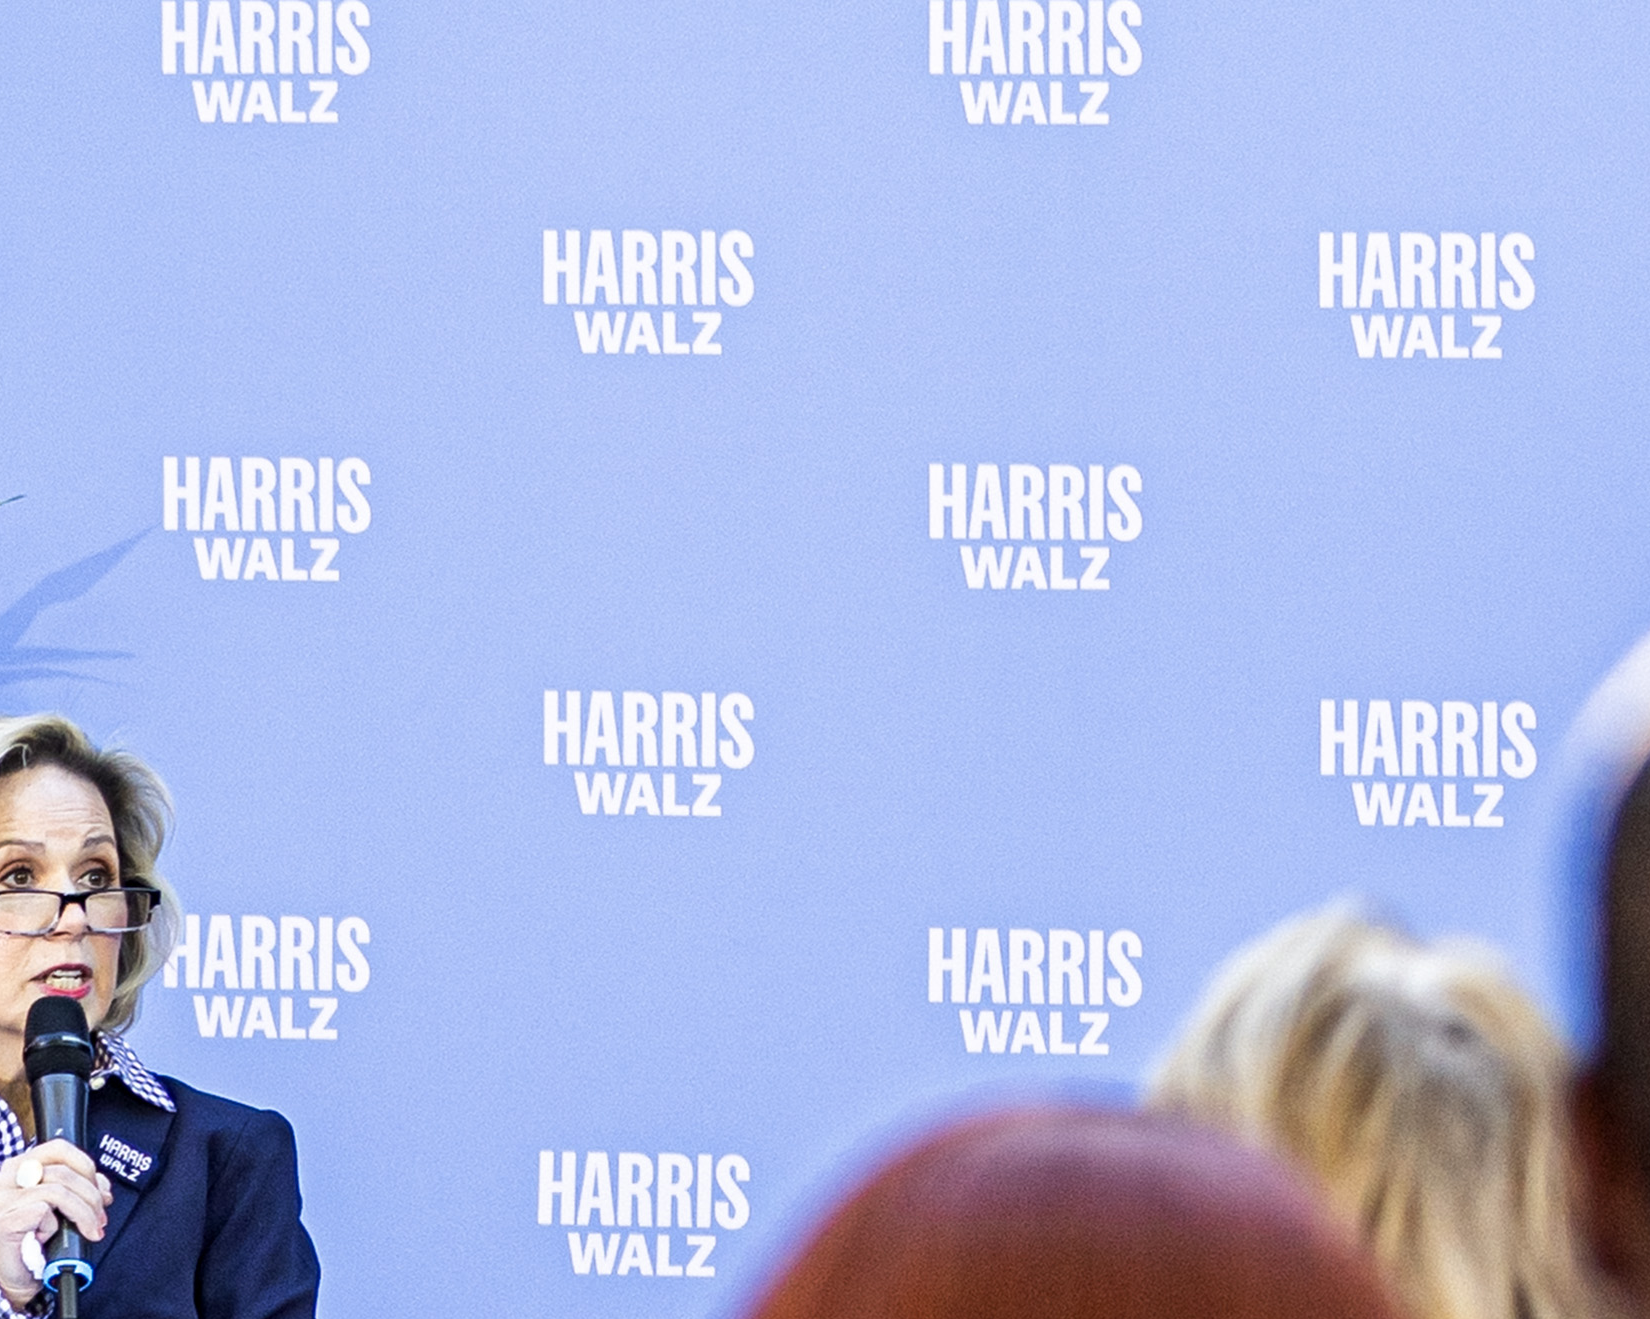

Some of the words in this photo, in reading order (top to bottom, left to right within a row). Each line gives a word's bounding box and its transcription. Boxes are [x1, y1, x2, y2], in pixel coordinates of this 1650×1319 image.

[162, 0, 371, 75] HARRIS
[930, 0, 1142, 75] HARRIS
[193, 81, 339, 122] WALZ
[960, 82, 1109, 124] WALZ
[543, 230, 754, 306] HARRIS
[1319, 232, 1535, 309] HARRIS
[574, 312, 721, 354] WALZ
[1351, 315, 1502, 358] WALZ
[163, 457, 371, 533] HARRIS
[930, 464, 1142, 541] HARRIS
[194, 538, 339, 581] WALZ
[961, 546, 1110, 589] WALZ
[544, 691, 754, 768] HARRIS
[1320, 700, 1536, 778] HARRIS
[575, 772, 721, 816] WALZ
[1352, 783, 1503, 826] WALZ
[163, 914, 370, 992] HARRIS
[929, 928, 1142, 1006] HARRIS
[194, 996, 338, 1039] WALZ
[960, 1011, 1109, 1054] WALZ
[99, 1134, 152, 1171] HARRIS
[100, 1153, 140, 1182] WALZ
[538, 1151, 749, 1229] HARRIS
[568, 1233, 716, 1276] WALZ
